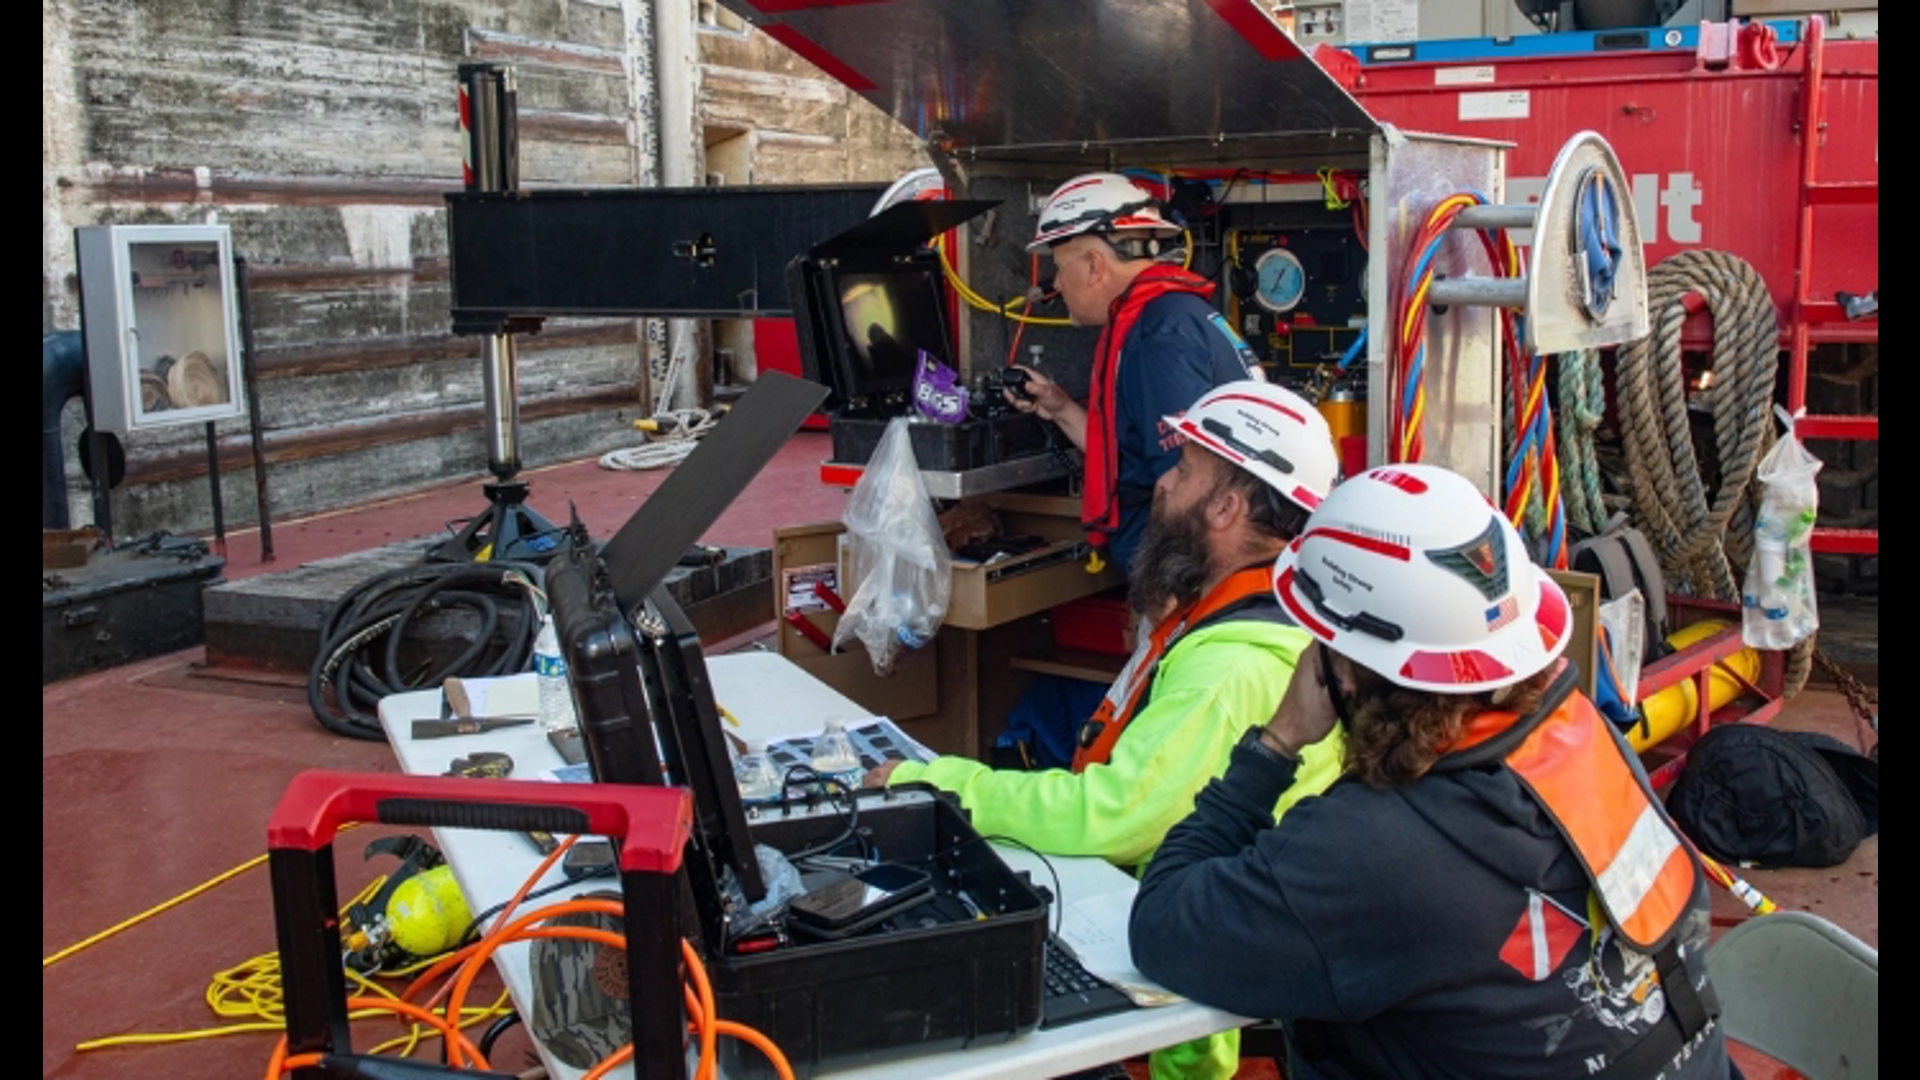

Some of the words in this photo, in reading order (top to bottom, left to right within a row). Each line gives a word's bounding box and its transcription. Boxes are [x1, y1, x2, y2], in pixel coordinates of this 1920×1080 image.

[637, 56, 646, 75] 3
[639, 94, 648, 115] 2
[649, 322, 658, 341] 6
[651, 359, 659, 378] 5
